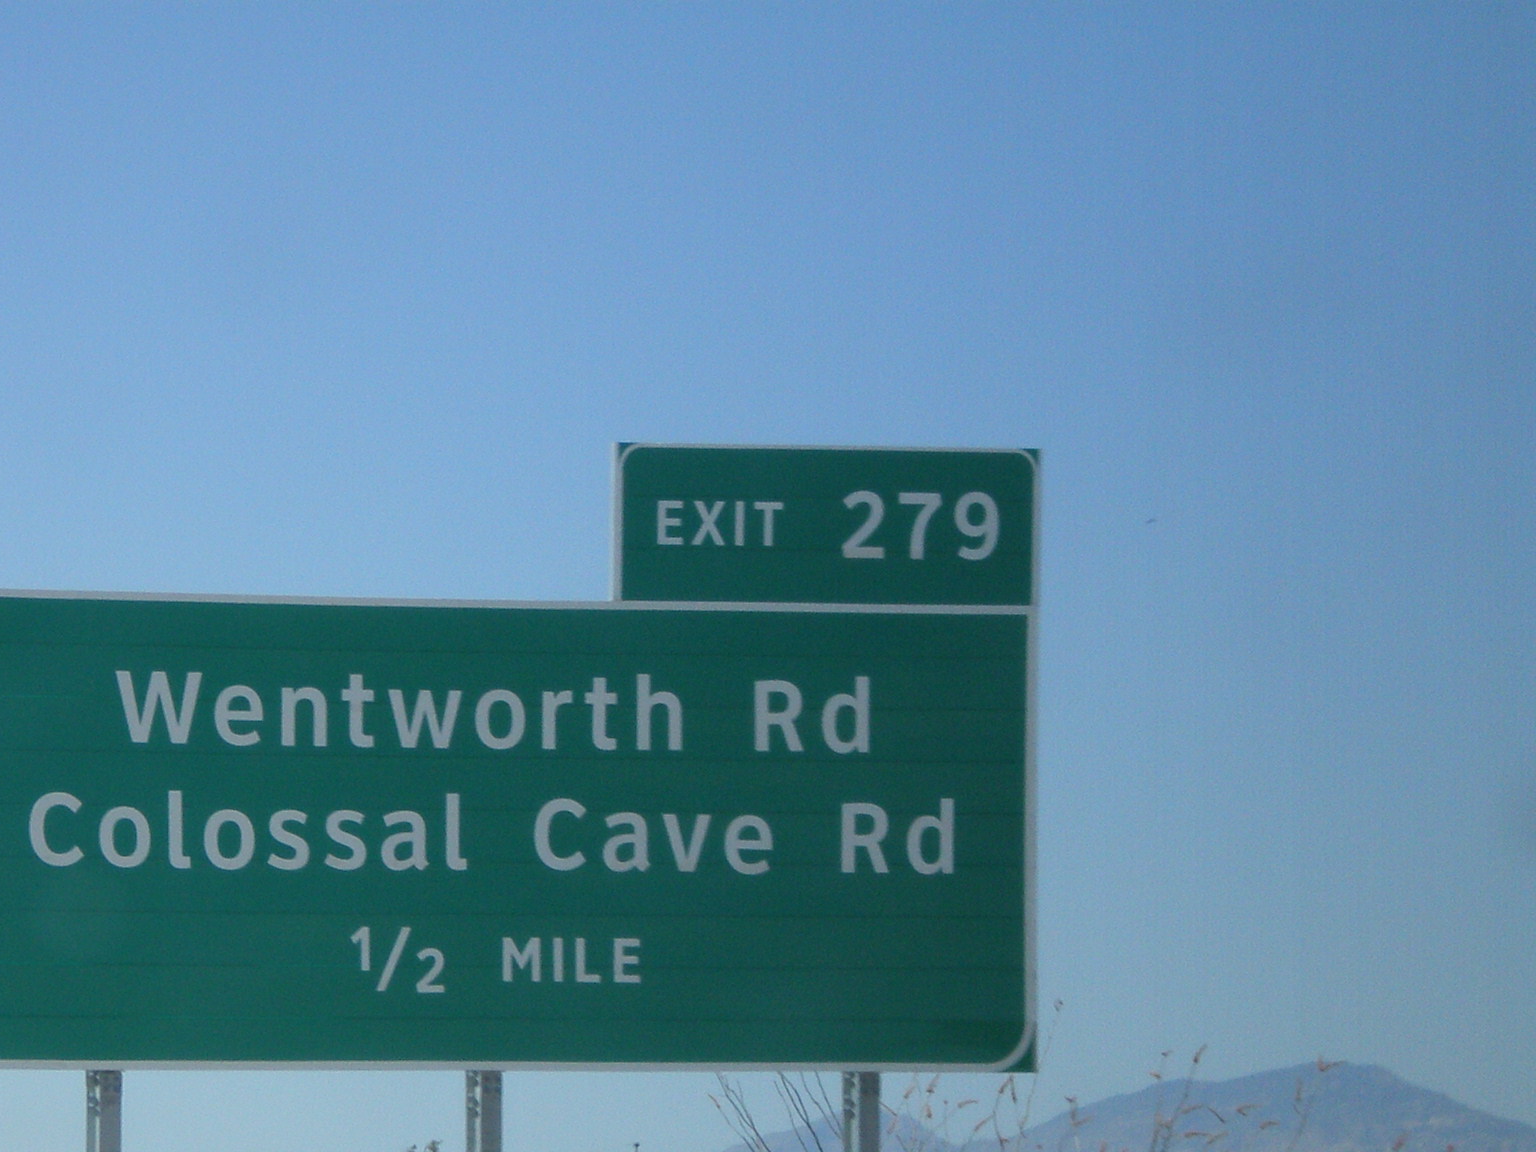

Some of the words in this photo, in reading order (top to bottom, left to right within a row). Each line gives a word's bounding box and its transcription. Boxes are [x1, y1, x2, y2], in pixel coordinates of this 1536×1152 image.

[654, 499, 786, 547] EXIT
[840, 490, 1002, 562] 279
[115, 669, 684, 751] Wentworth
[753, 676, 872, 755] Rd
[28, 790, 468, 871] Colossal
[533, 797, 775, 875] Cave
[840, 798, 956, 876] Rd
[350, 925, 447, 995] 1/2
[501, 937, 643, 984] MILE
